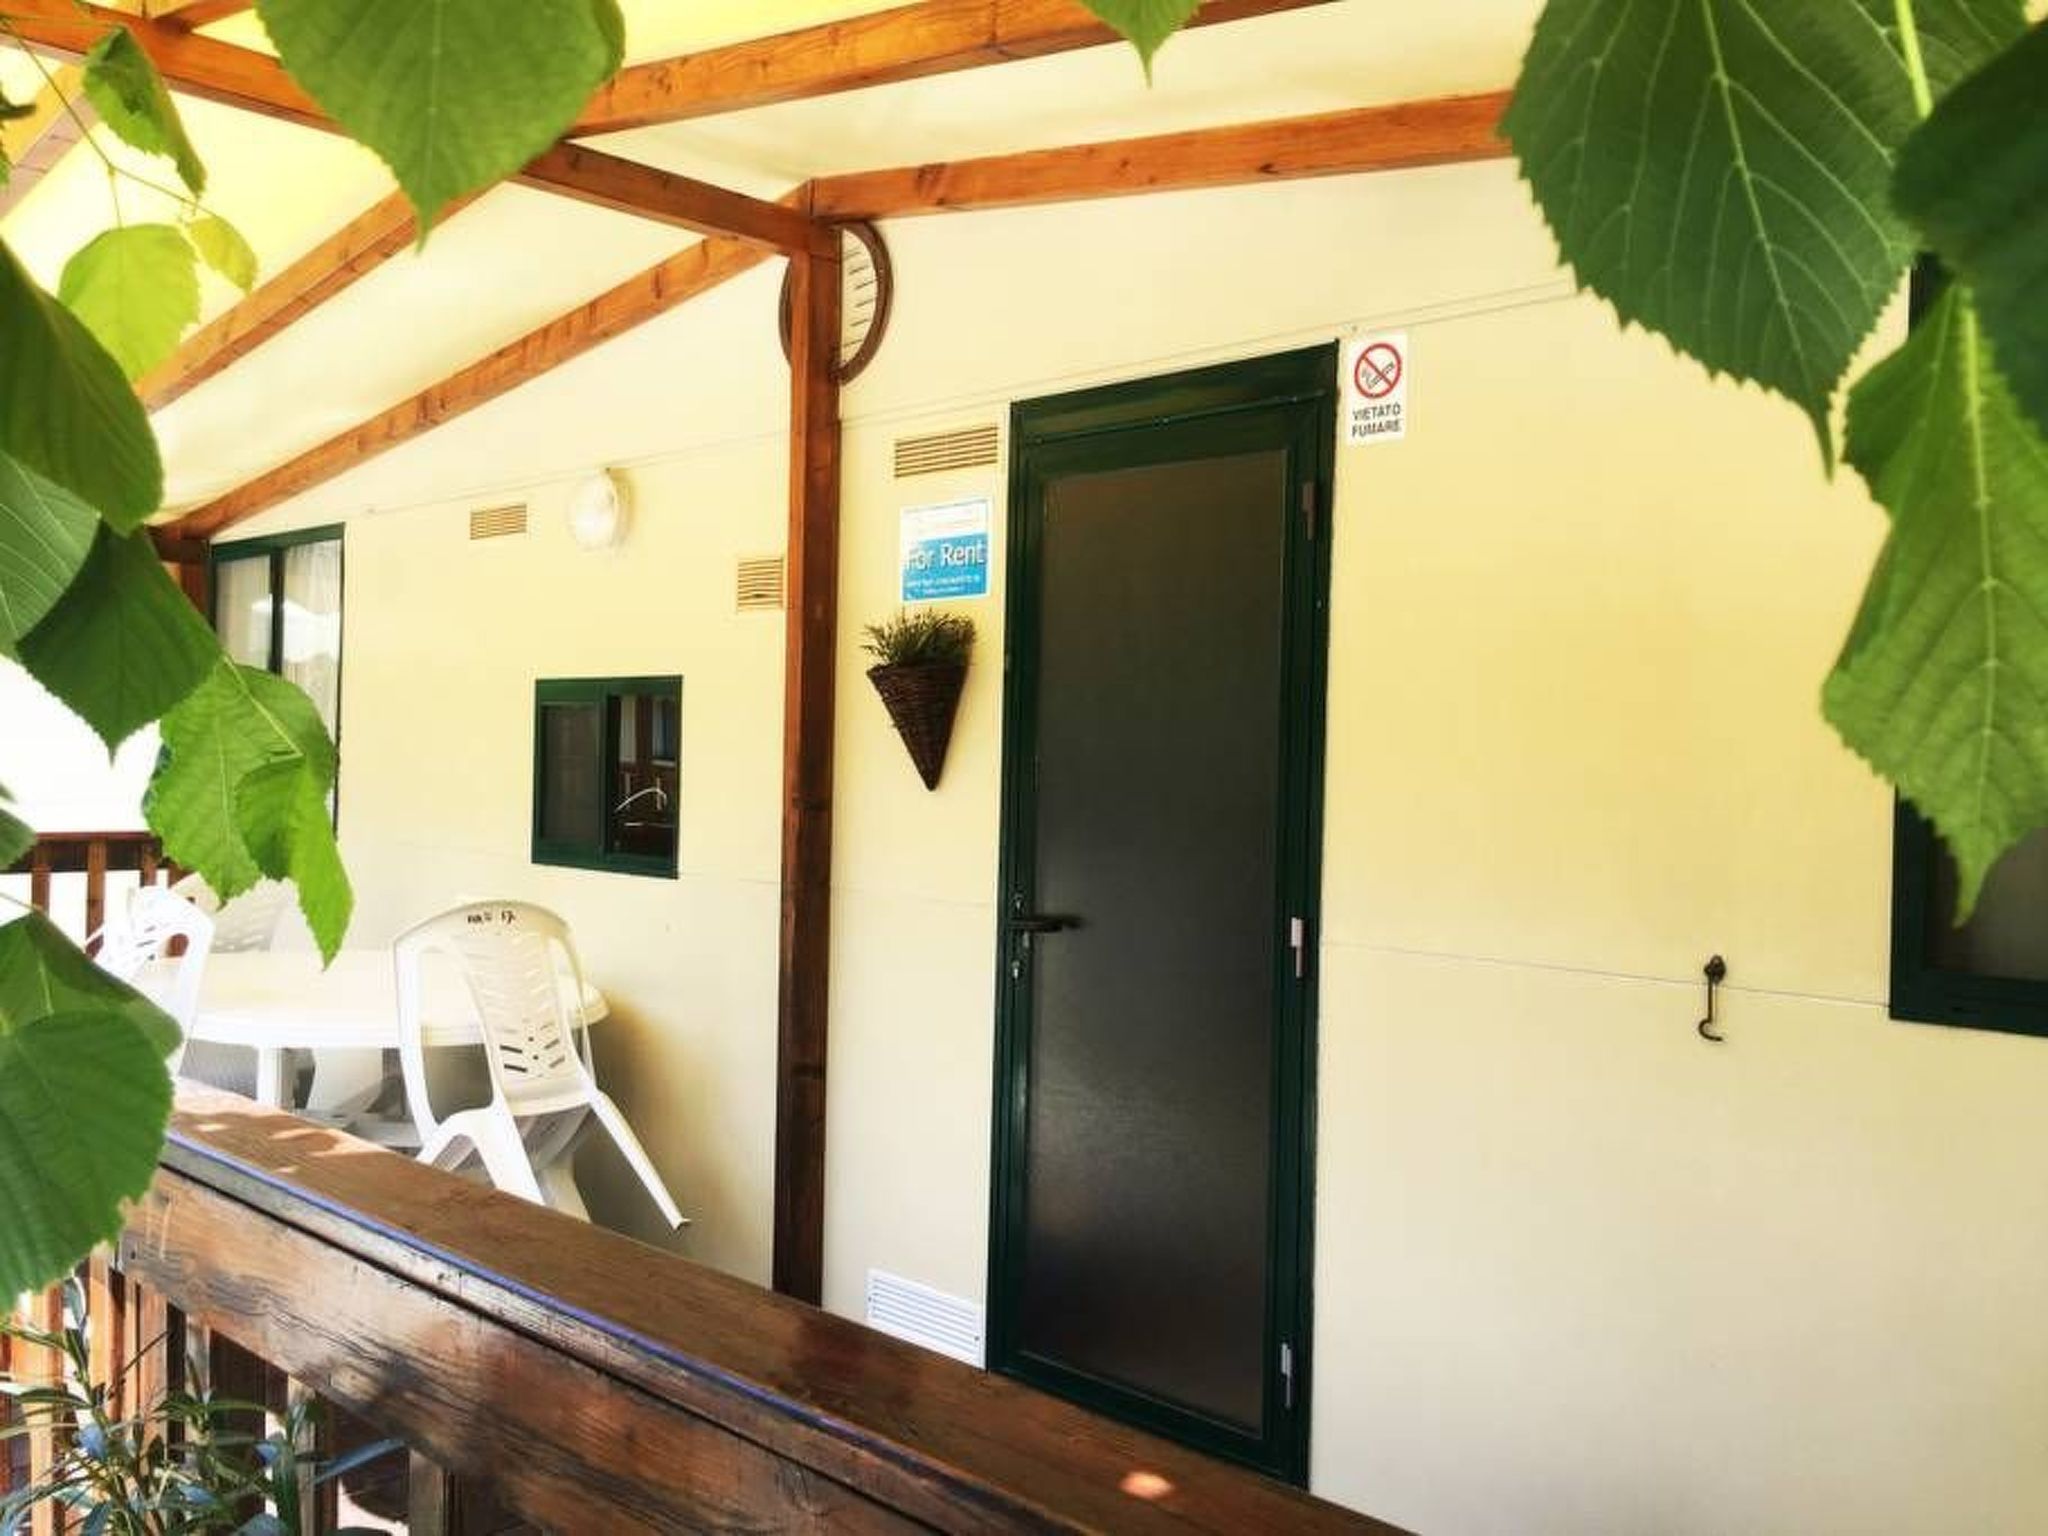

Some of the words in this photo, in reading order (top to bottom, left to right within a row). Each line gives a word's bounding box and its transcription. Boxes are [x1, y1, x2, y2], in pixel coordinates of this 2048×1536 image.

[1352, 402, 1401, 421] VIETATO
[1351, 420, 1401, 437] FUMARE
[941, 540, 986, 567] Rent
